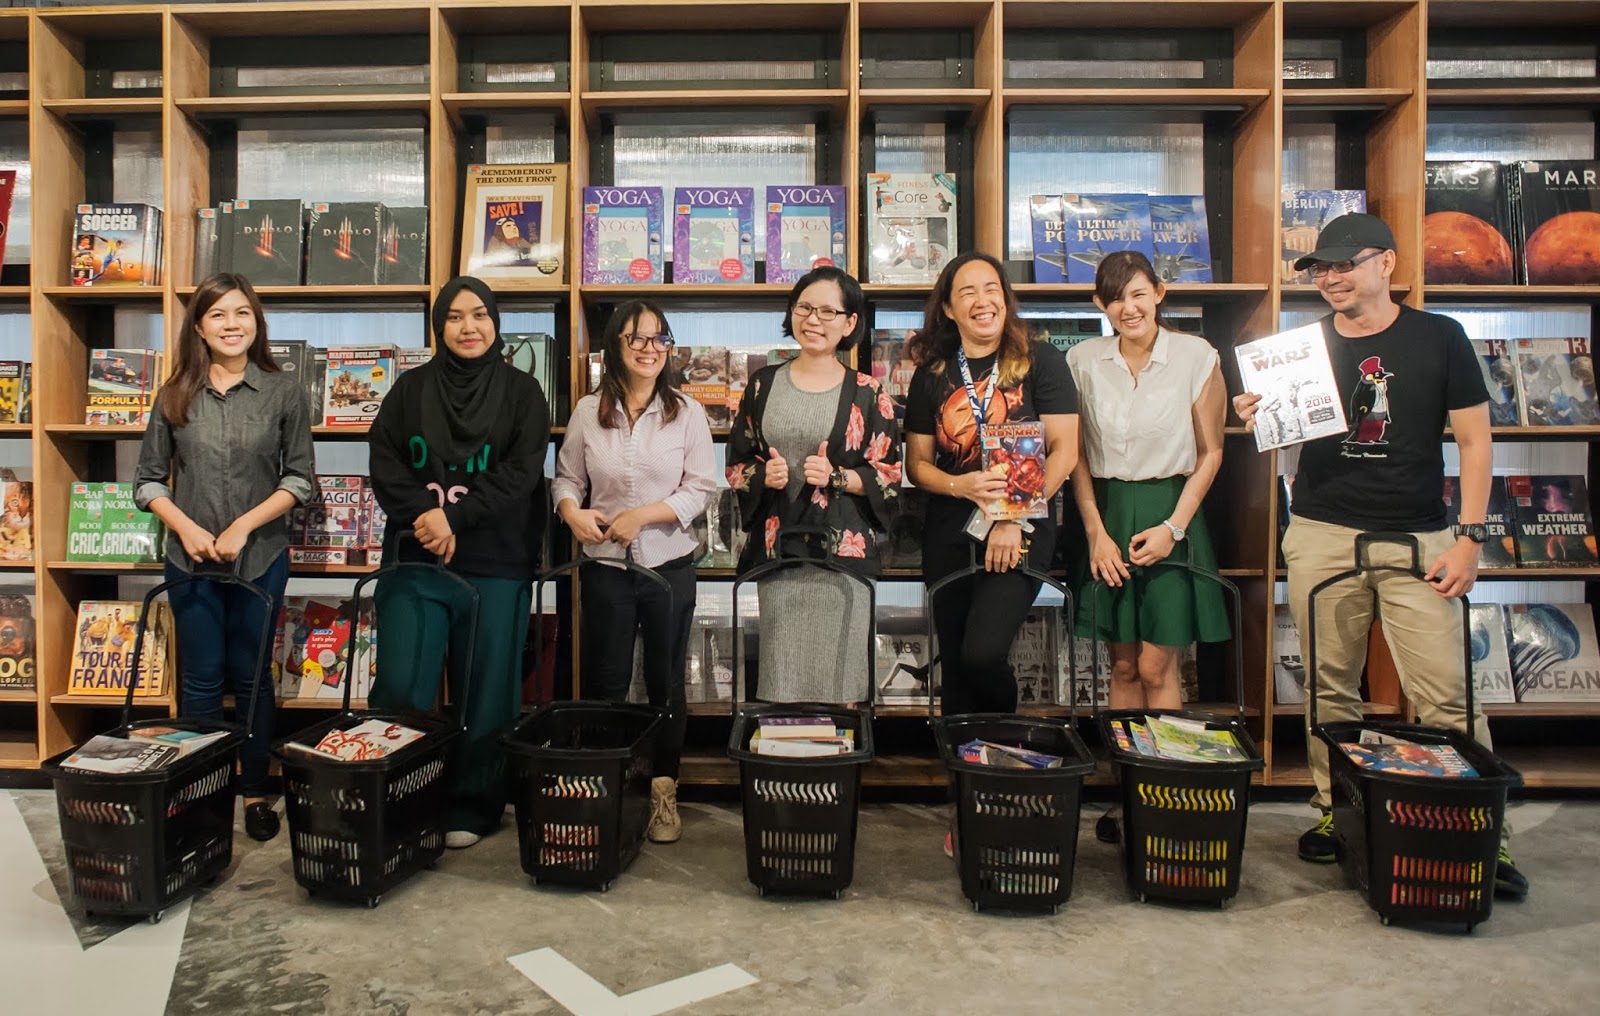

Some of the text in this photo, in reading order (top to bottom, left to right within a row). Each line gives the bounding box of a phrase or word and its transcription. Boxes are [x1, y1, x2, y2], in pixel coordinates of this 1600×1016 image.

[1544, 170, 1597, 185] MAR
[595, 189, 652, 204] YOGA
[686, 190, 744, 205] YOGA
[777, 188, 835, 204] YOGA
[894, 191, 928, 204] Core
[1285, 199, 1326, 210] BERLIN
[82, 214, 138, 231] SOCCER
[600, 221, 646, 232] YOGA
[783, 220, 830, 231] YOGA
[1078, 220, 1140, 230] ULTIMATE
[1152, 222, 1195, 231] TIMATE
[1078, 230, 1142, 242] POWER
[1252, 346, 1312, 372] WARS
[90, 396, 147, 405] FORMULA 1
[1305, 396, 1332, 408] 2018
[1538, 514, 1586, 522] EXTREME
[1522, 524, 1588, 536] WEATHER
[70, 532, 100, 554] CRIC
[102, 532, 157, 555] CRICKET
[0, 657, 33, 678] OG
[81, 652, 122, 668] TOUR
[73, 669, 146, 688] FRANCE
[1523, 670, 1600, 690] OCEAN
